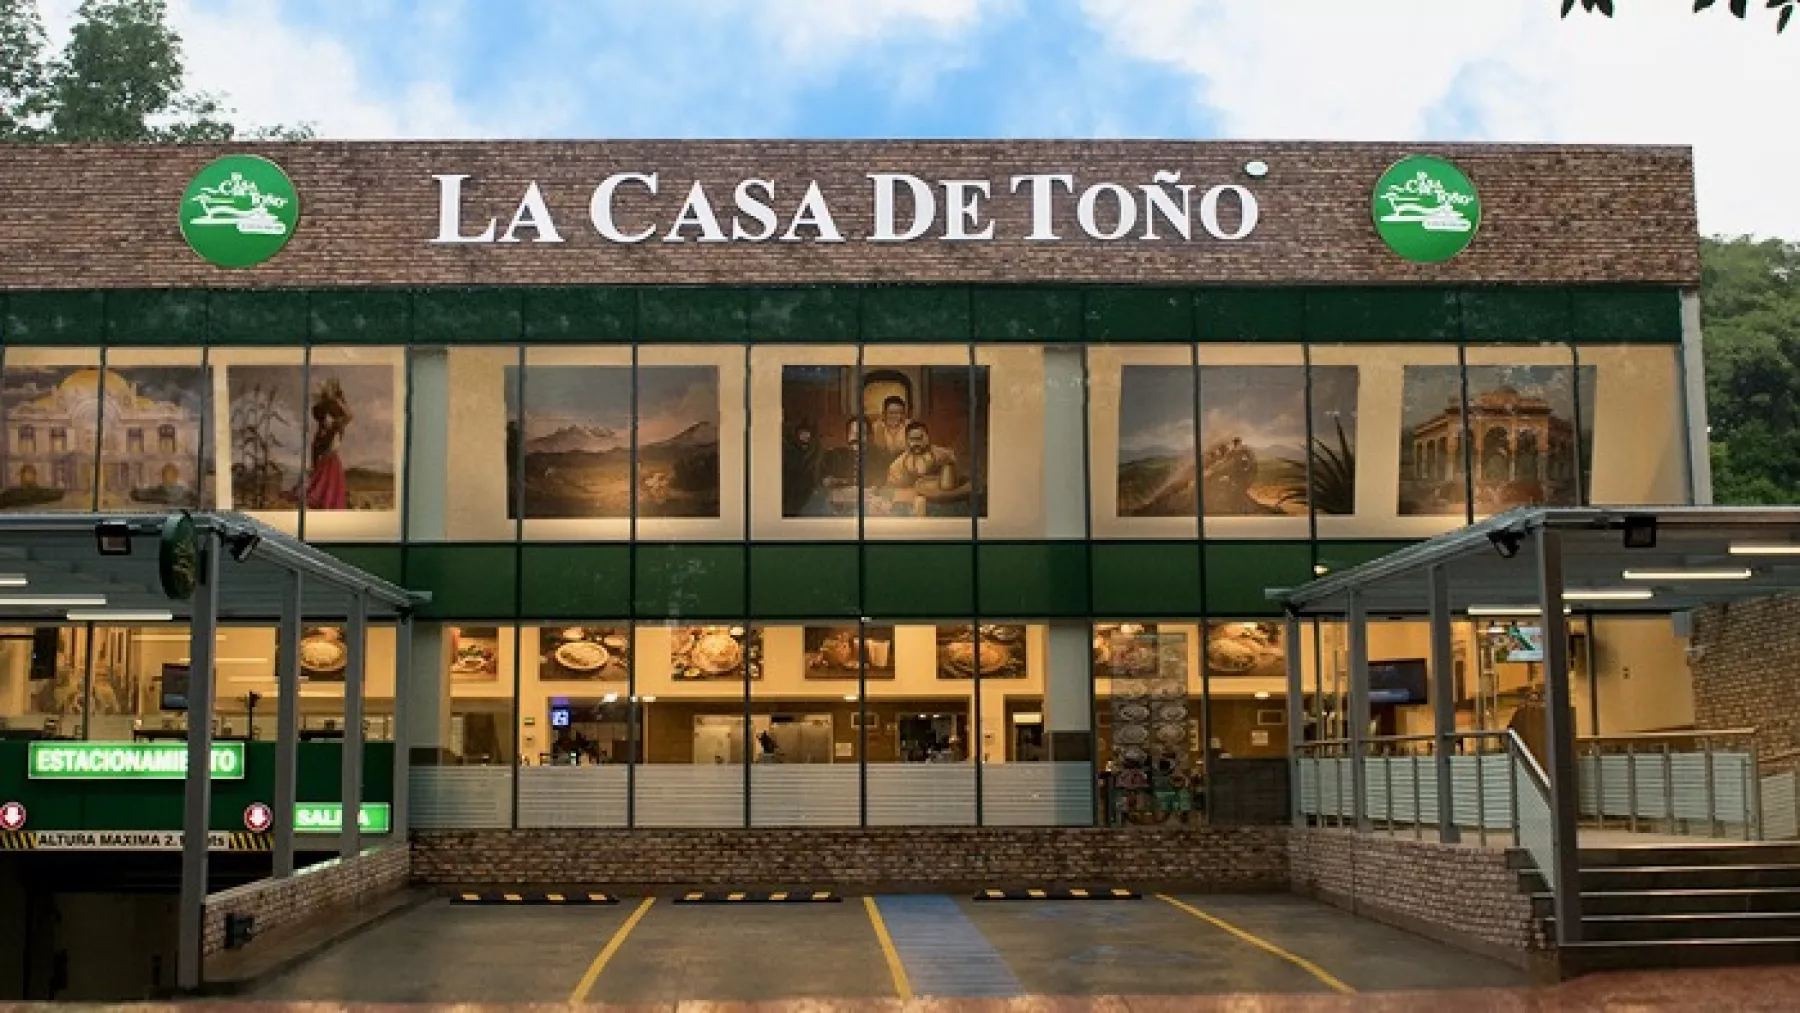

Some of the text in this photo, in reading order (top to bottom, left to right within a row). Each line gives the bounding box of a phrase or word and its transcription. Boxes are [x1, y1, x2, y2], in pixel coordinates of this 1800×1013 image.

[429, 169, 1259, 244] LA CASA DE TOÑO
[35, 749, 236, 773] ESTACIONAMIETO
[297, 808, 371, 826] SALIA
[38, 834, 96, 846] ALTURA
[100, 834, 160, 846] MAXIMA
